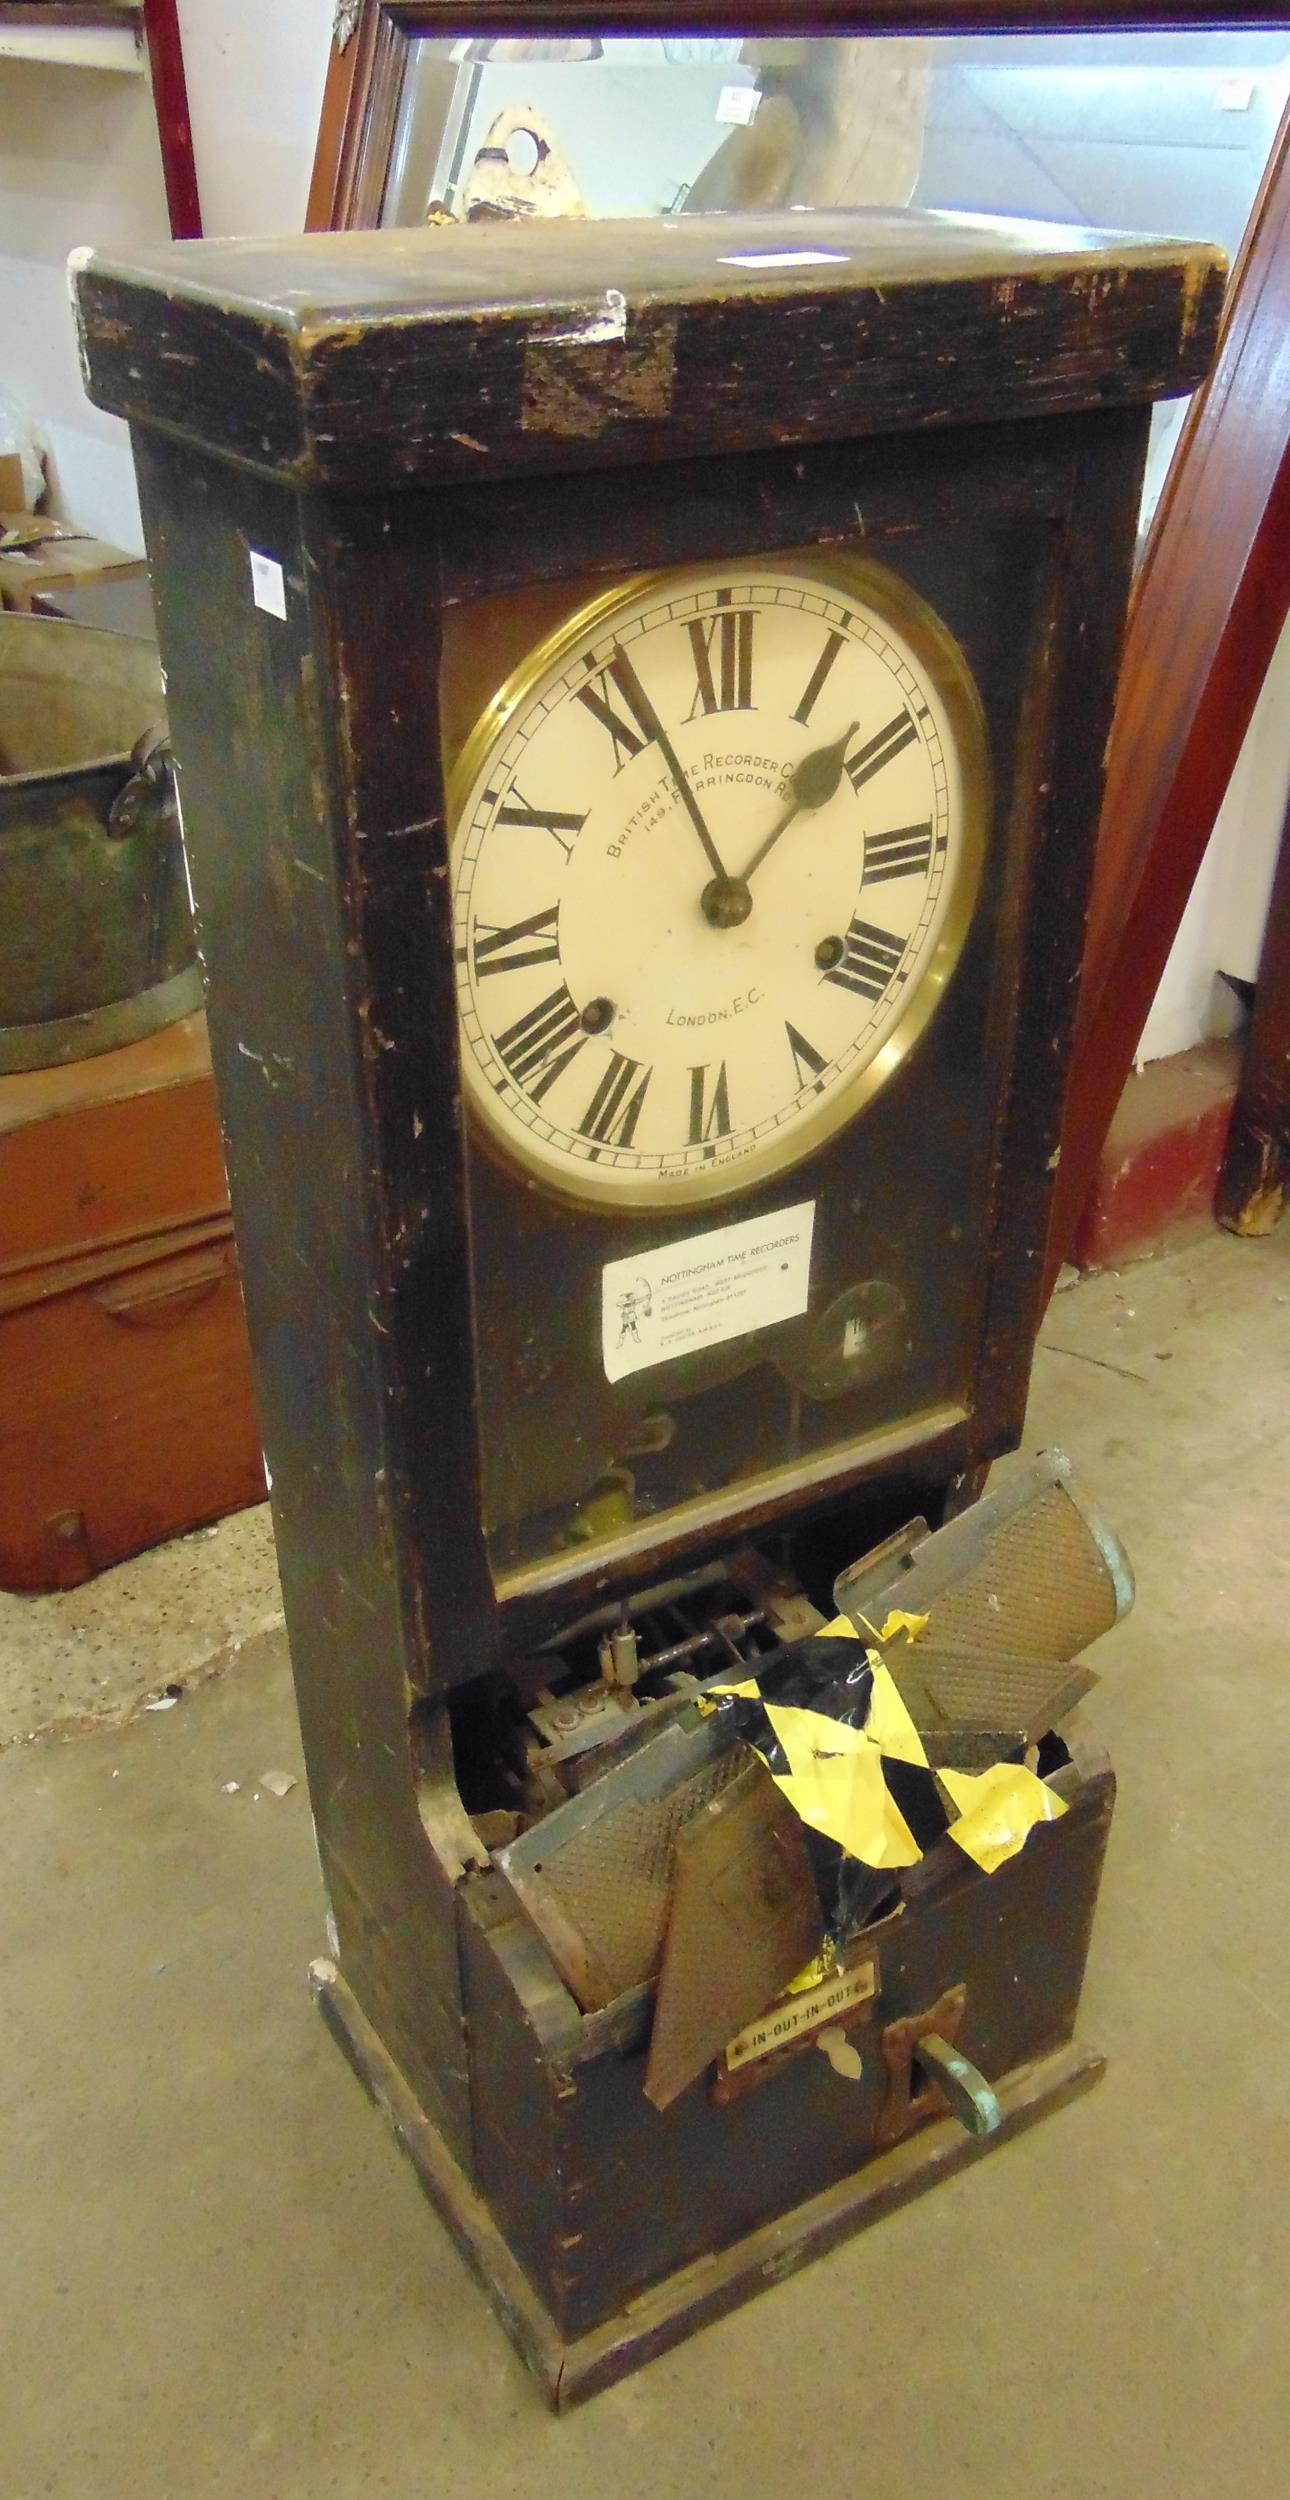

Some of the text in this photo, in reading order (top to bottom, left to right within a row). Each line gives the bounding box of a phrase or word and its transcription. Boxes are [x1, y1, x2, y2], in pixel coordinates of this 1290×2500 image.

[680, 610, 762, 725] XII
[789, 627, 850, 727] I
[492, 776, 592, 866] X
[606, 790, 660, 859] BRITISH
[703, 753, 779, 772] RECORDER
[671, 773, 774, 805] FRRINGDON
[860, 814, 933, 893] III
[474, 898, 562, 986] IX
[491, 978, 590, 1108] VIII
[785, 1019, 833, 1095] V
[571, 1048, 654, 1150] VII
[684, 1060, 736, 1147] VI
[658, 1168, 689, 1180] MADE
[711, 1145, 756, 1167] ENGLAND
[661, 1259, 725, 1286] NOTTINGHAM
[727, 1250, 748, 1265] TIME
[750, 1233, 801, 1257] RECORDERS
